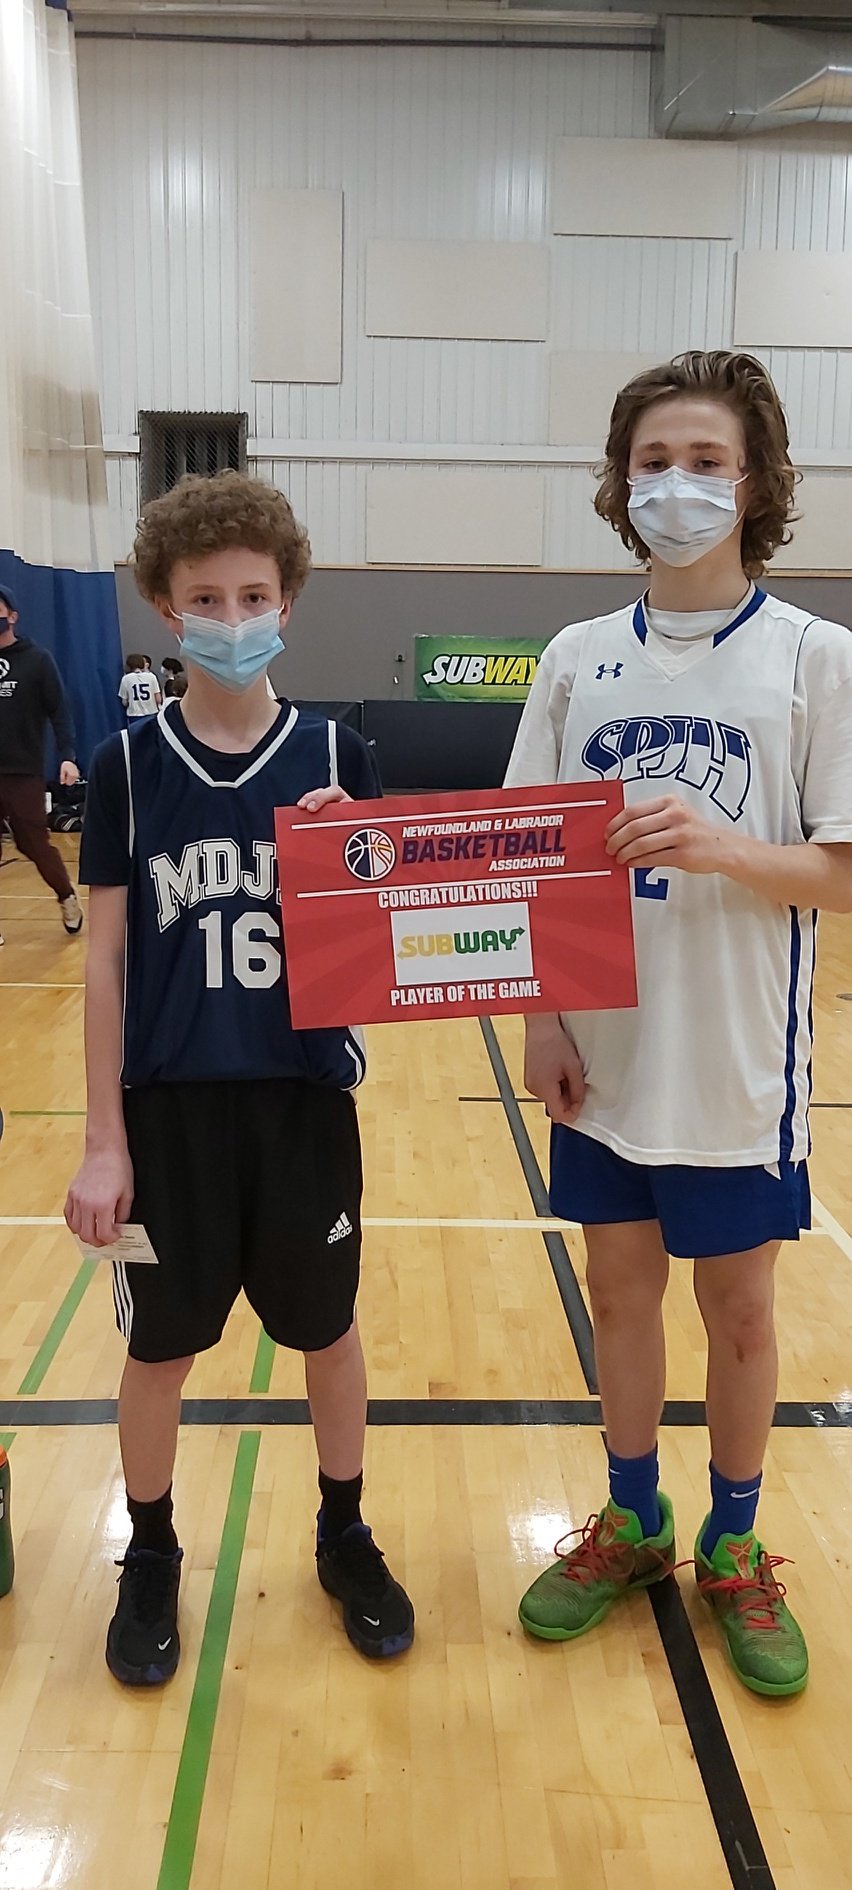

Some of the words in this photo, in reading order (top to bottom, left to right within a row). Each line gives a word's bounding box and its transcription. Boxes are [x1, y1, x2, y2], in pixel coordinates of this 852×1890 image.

[132, 683, 150, 701] 15
[581, 715, 752, 822] SPJH
[402, 820, 491, 838] NEWFOUNDLAND
[494, 819, 502, 831] &
[505, 815, 564, 830] LABRADOR
[402, 829, 566, 864] BASKETBALL
[489, 855, 565, 872] ASSOCIATION
[148, 838, 282, 933] MDJ
[378, 881, 538, 908] CONGRATULATIONS!!!
[198, 910, 281, 988] 16
[397, 926, 526, 960] SUBWAY
[391, 986, 444, 1006] PLAYER
[447, 985, 465, 1002] OF
[466, 983, 495, 1000] THE
[499, 980, 541, 999] GAME
[327, 1224, 353, 1244] adidas
